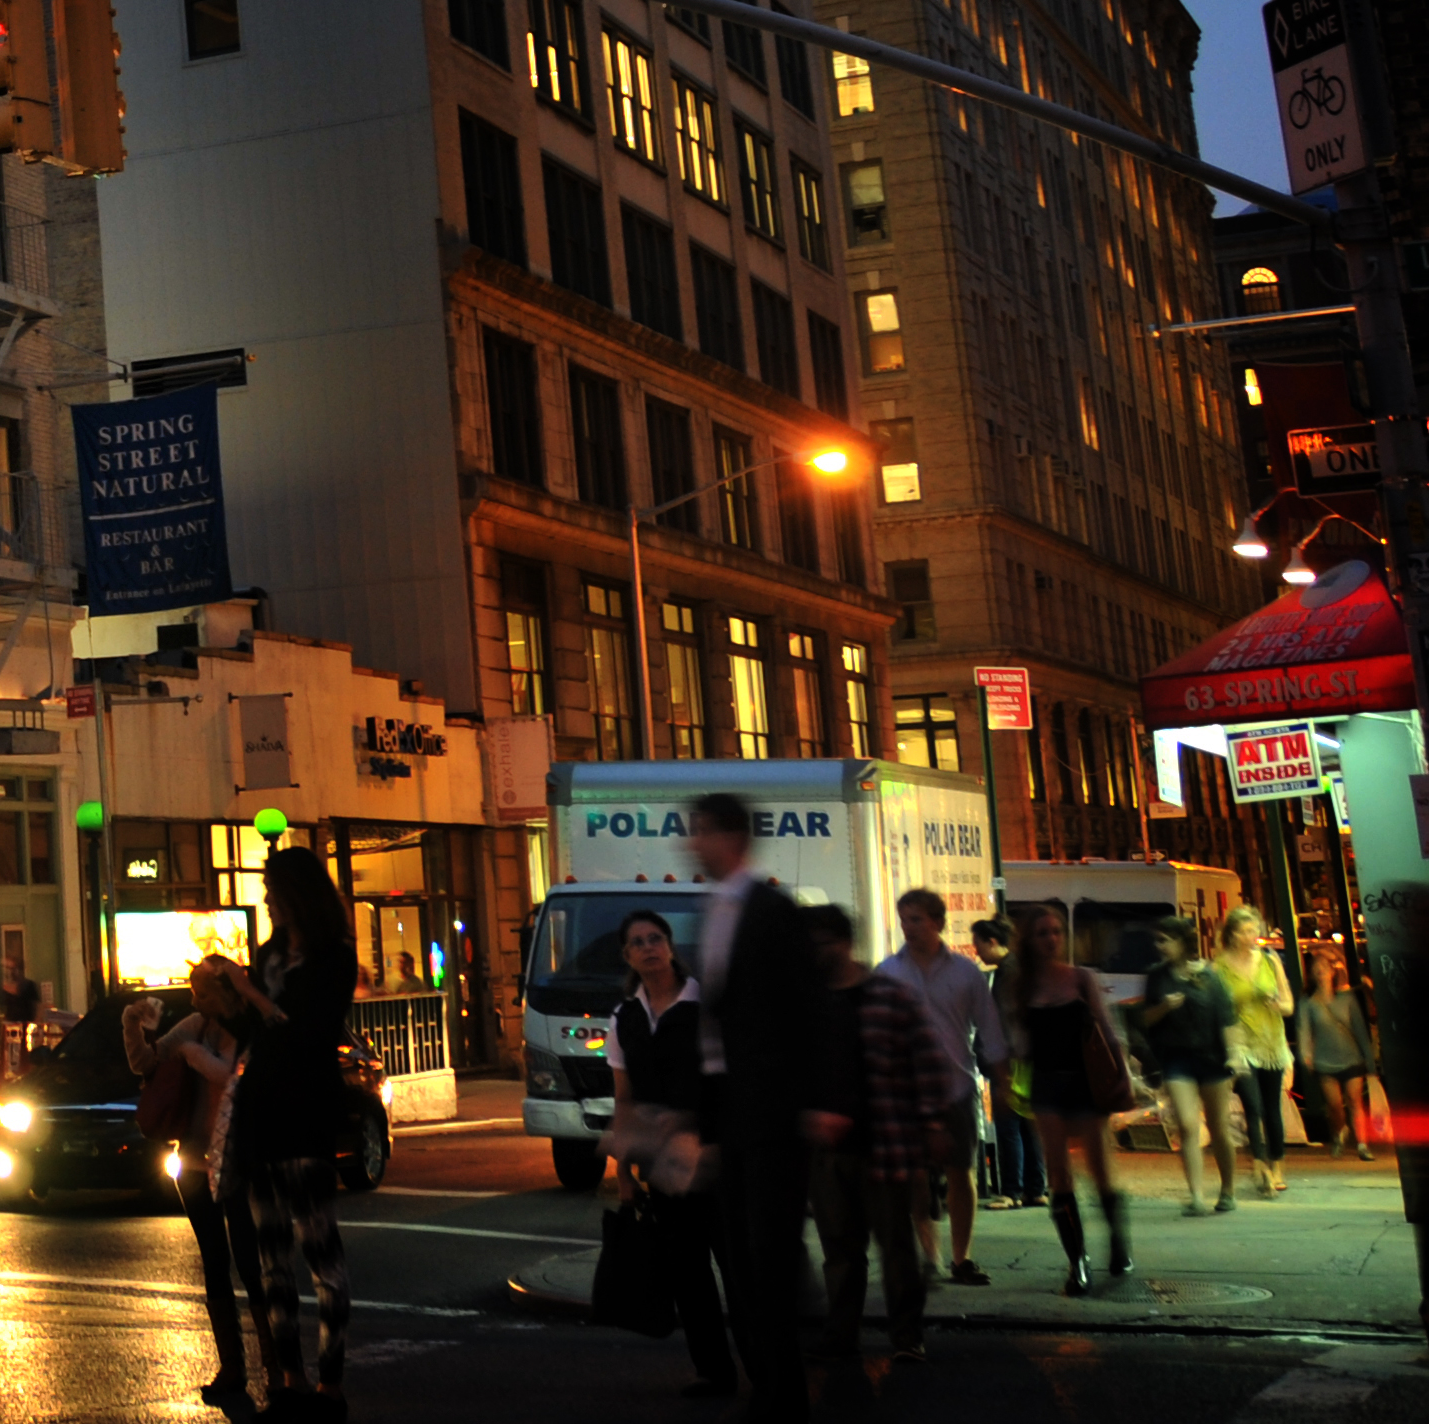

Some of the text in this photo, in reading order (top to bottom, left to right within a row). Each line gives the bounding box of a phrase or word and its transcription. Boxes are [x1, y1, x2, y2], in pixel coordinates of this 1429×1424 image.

[1292, 14, 1339, 50] LANE
[1304, 135, 1346, 172] ONLY
[97, 414, 194, 446] SPRING
[97, 439, 199, 472] STREET
[91, 466, 211, 500] NATURAL
[100, 519, 209, 548] RESTAURANT
[140, 557, 175, 575] BAR
[150, 544, 161, 557] &
[1219, 623, 1366, 656] 24 HRS ATM
[1203, 640, 1351, 673] MAGAZINES
[1184, 670, 1371, 712] 63 SPRING ST.
[498, 726, 514, 788] exhale
[1236, 733, 1309, 767] ATM
[1238, 762, 1312, 784] INSIDE
[749, 812, 831, 838] EAR
[924, 821, 957, 856] POLAR
[958, 824, 982, 858] BEAR
